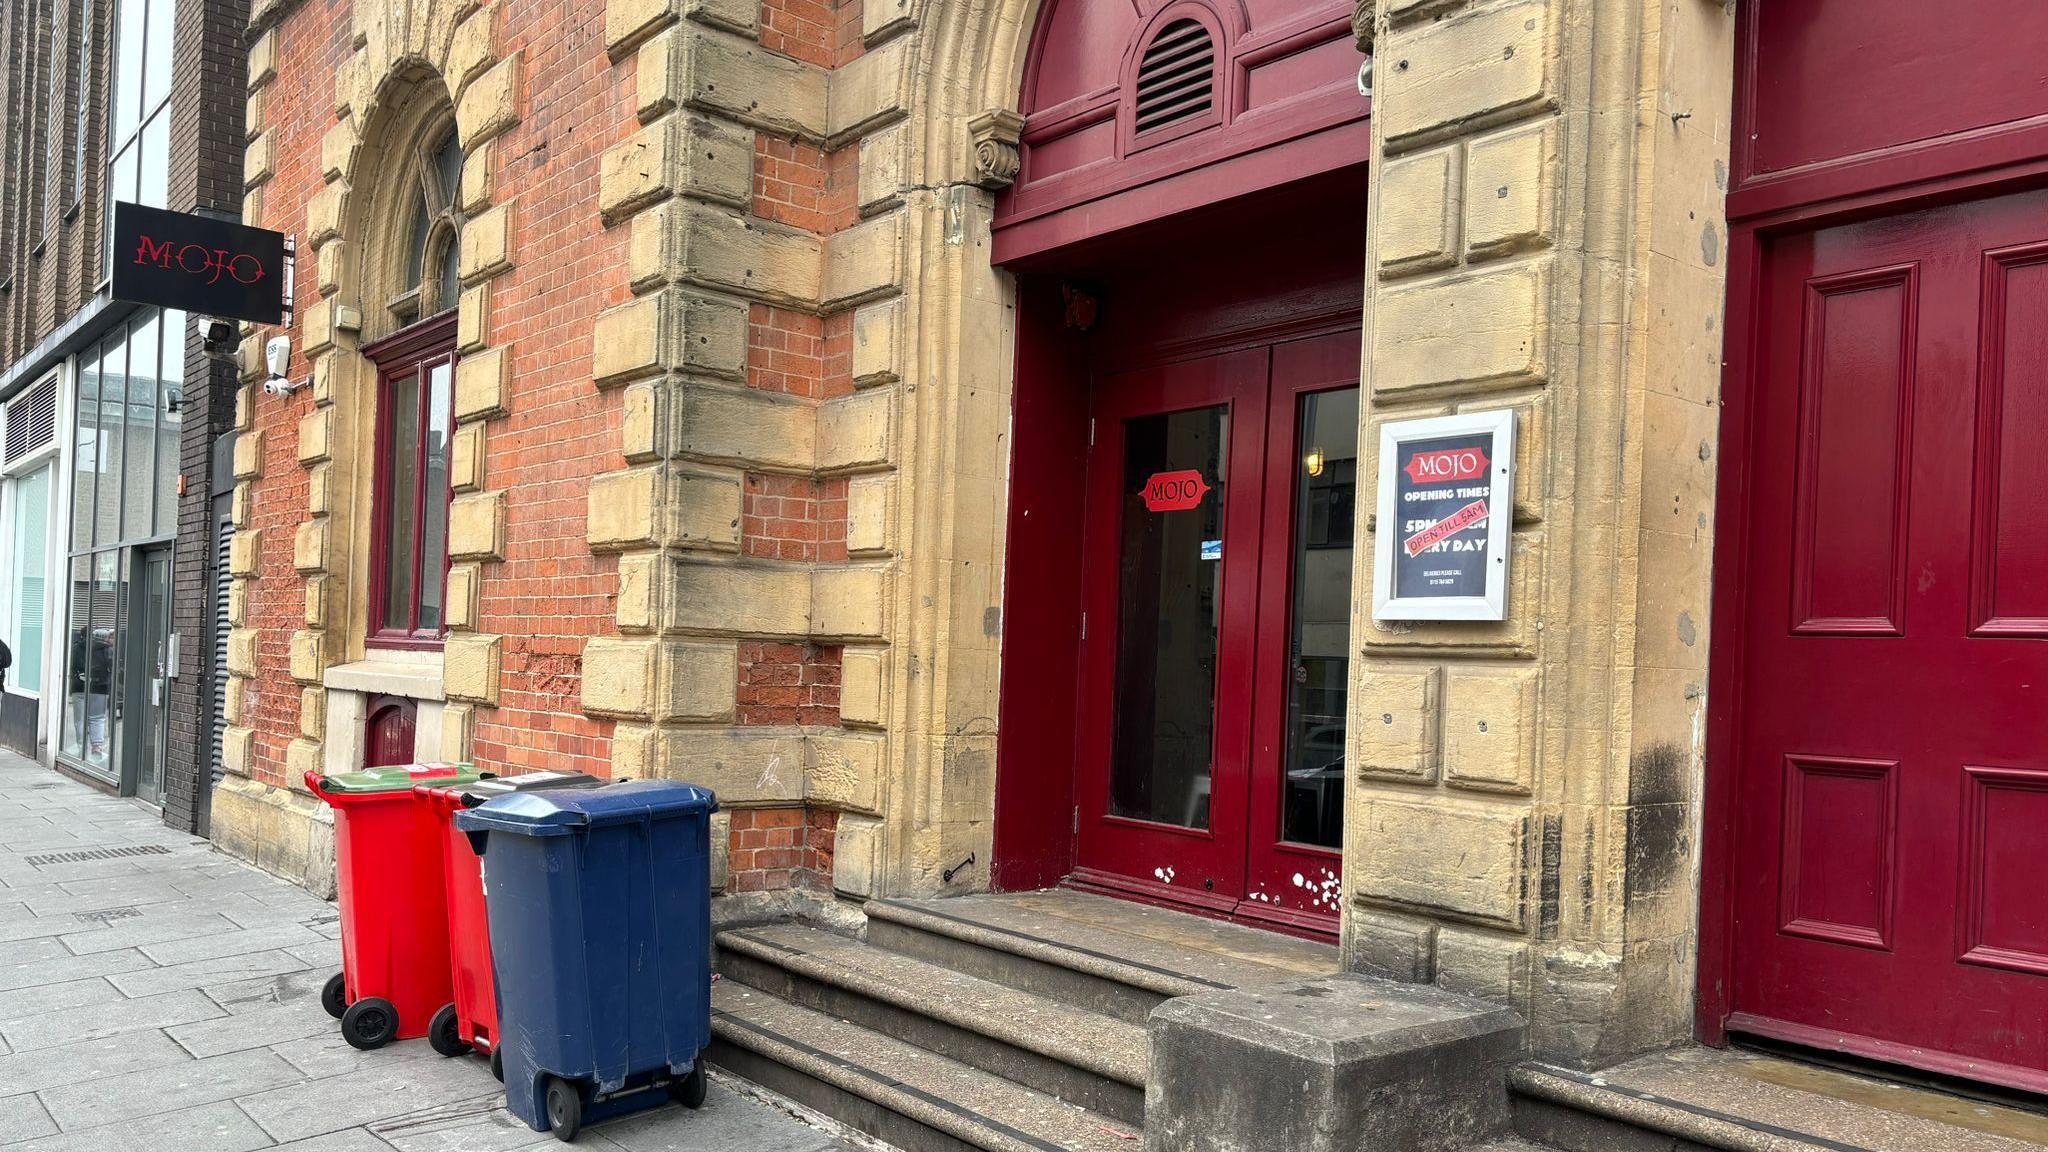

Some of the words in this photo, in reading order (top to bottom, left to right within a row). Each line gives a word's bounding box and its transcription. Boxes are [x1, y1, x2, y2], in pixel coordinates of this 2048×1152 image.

[134, 235, 264, 285] MOJO
[1418, 453, 1477, 479] MOJO
[1150, 479, 1198, 502] MOJO
[1404, 489, 1454, 502] OPENING
[1456, 486, 1490, 498] TIMES
[1410, 529, 1438, 551] OPEN
[1439, 519, 1460, 535] TILL
[1461, 504, 1484, 523] 5AM
[1404, 540, 1451, 554] ERY
[1453, 538, 1487, 552] DAY
